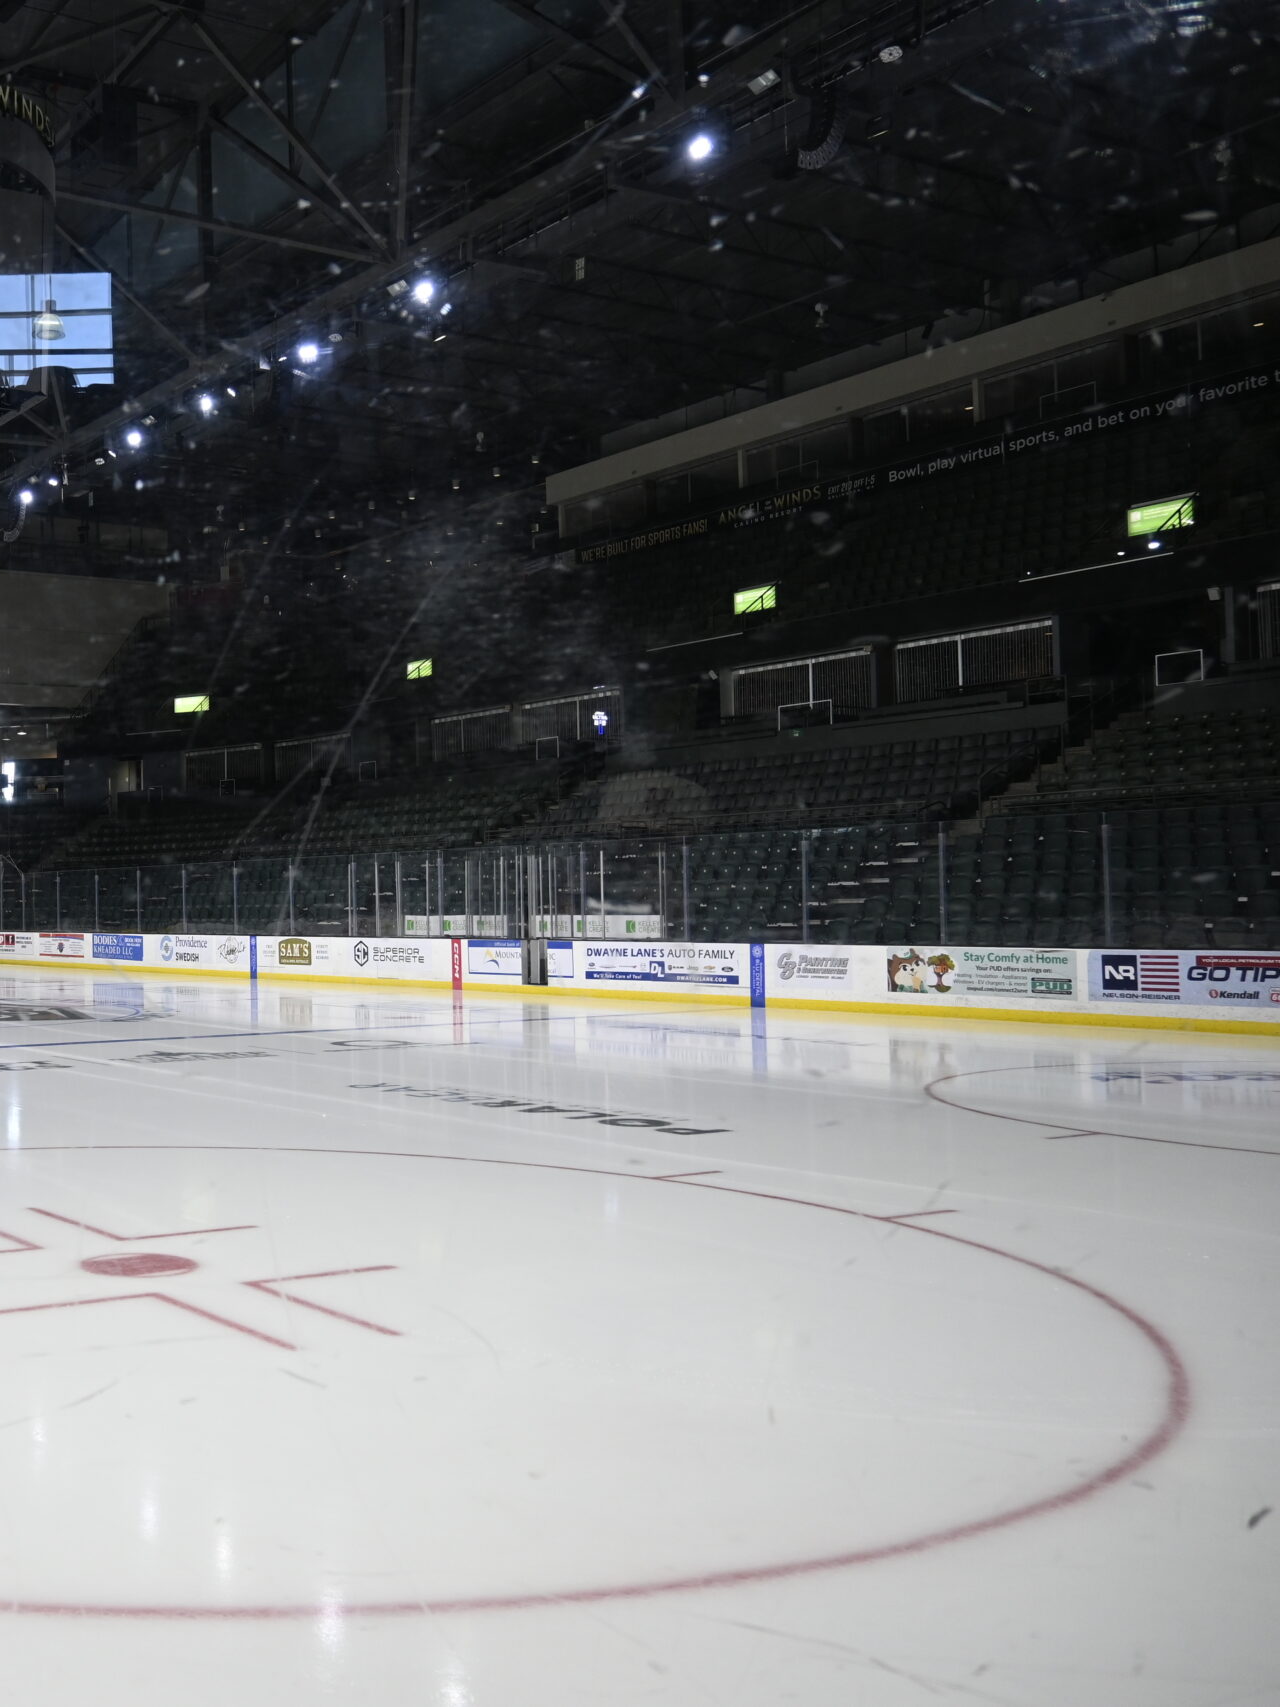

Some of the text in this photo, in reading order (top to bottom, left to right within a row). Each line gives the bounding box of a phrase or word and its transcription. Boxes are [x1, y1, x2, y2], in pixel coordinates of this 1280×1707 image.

[888, 461, 924, 483] Bowl,
[928, 456, 956, 475] play
[960, 442, 1004, 465] virtual
[1008, 430, 1059, 453] sports,
[1064, 418, 1092, 437] and
[1097, 411, 1124, 430] bet
[1129, 406, 1150, 422] on
[1199, 375, 1268, 403] favorite
[774, 485, 820, 509] WINDS
[581, 519, 708, 563] WE'RE BUILT FOR SPORTS FANS!
[93, 935, 117, 945] BODIES
[175, 936, 207, 948] Providence
[93, 945, 133, 955] KNEADED LLC
[280, 942, 309, 957] SAM'S
[373, 947, 419, 955] SUPERIOR
[495, 950, 521, 959] MOUNTA
[587, 948, 735, 959] DWAYNE LANE'S AUTO FAMILY
[175, 953, 199, 962] SWEDISH
[373, 954, 424, 963] CONCRETE
[798, 955, 849, 967] PAINTING
[963, 952, 1068, 964] Stay Comfy at Home
[1104, 965, 1136, 980] NR
[1187, 966, 1280, 982] GO TIP
[1031, 981, 1072, 990] PUD
[1102, 992, 1181, 1001] NELSON-REISNER
[1219, 990, 1260, 999] Kendall
